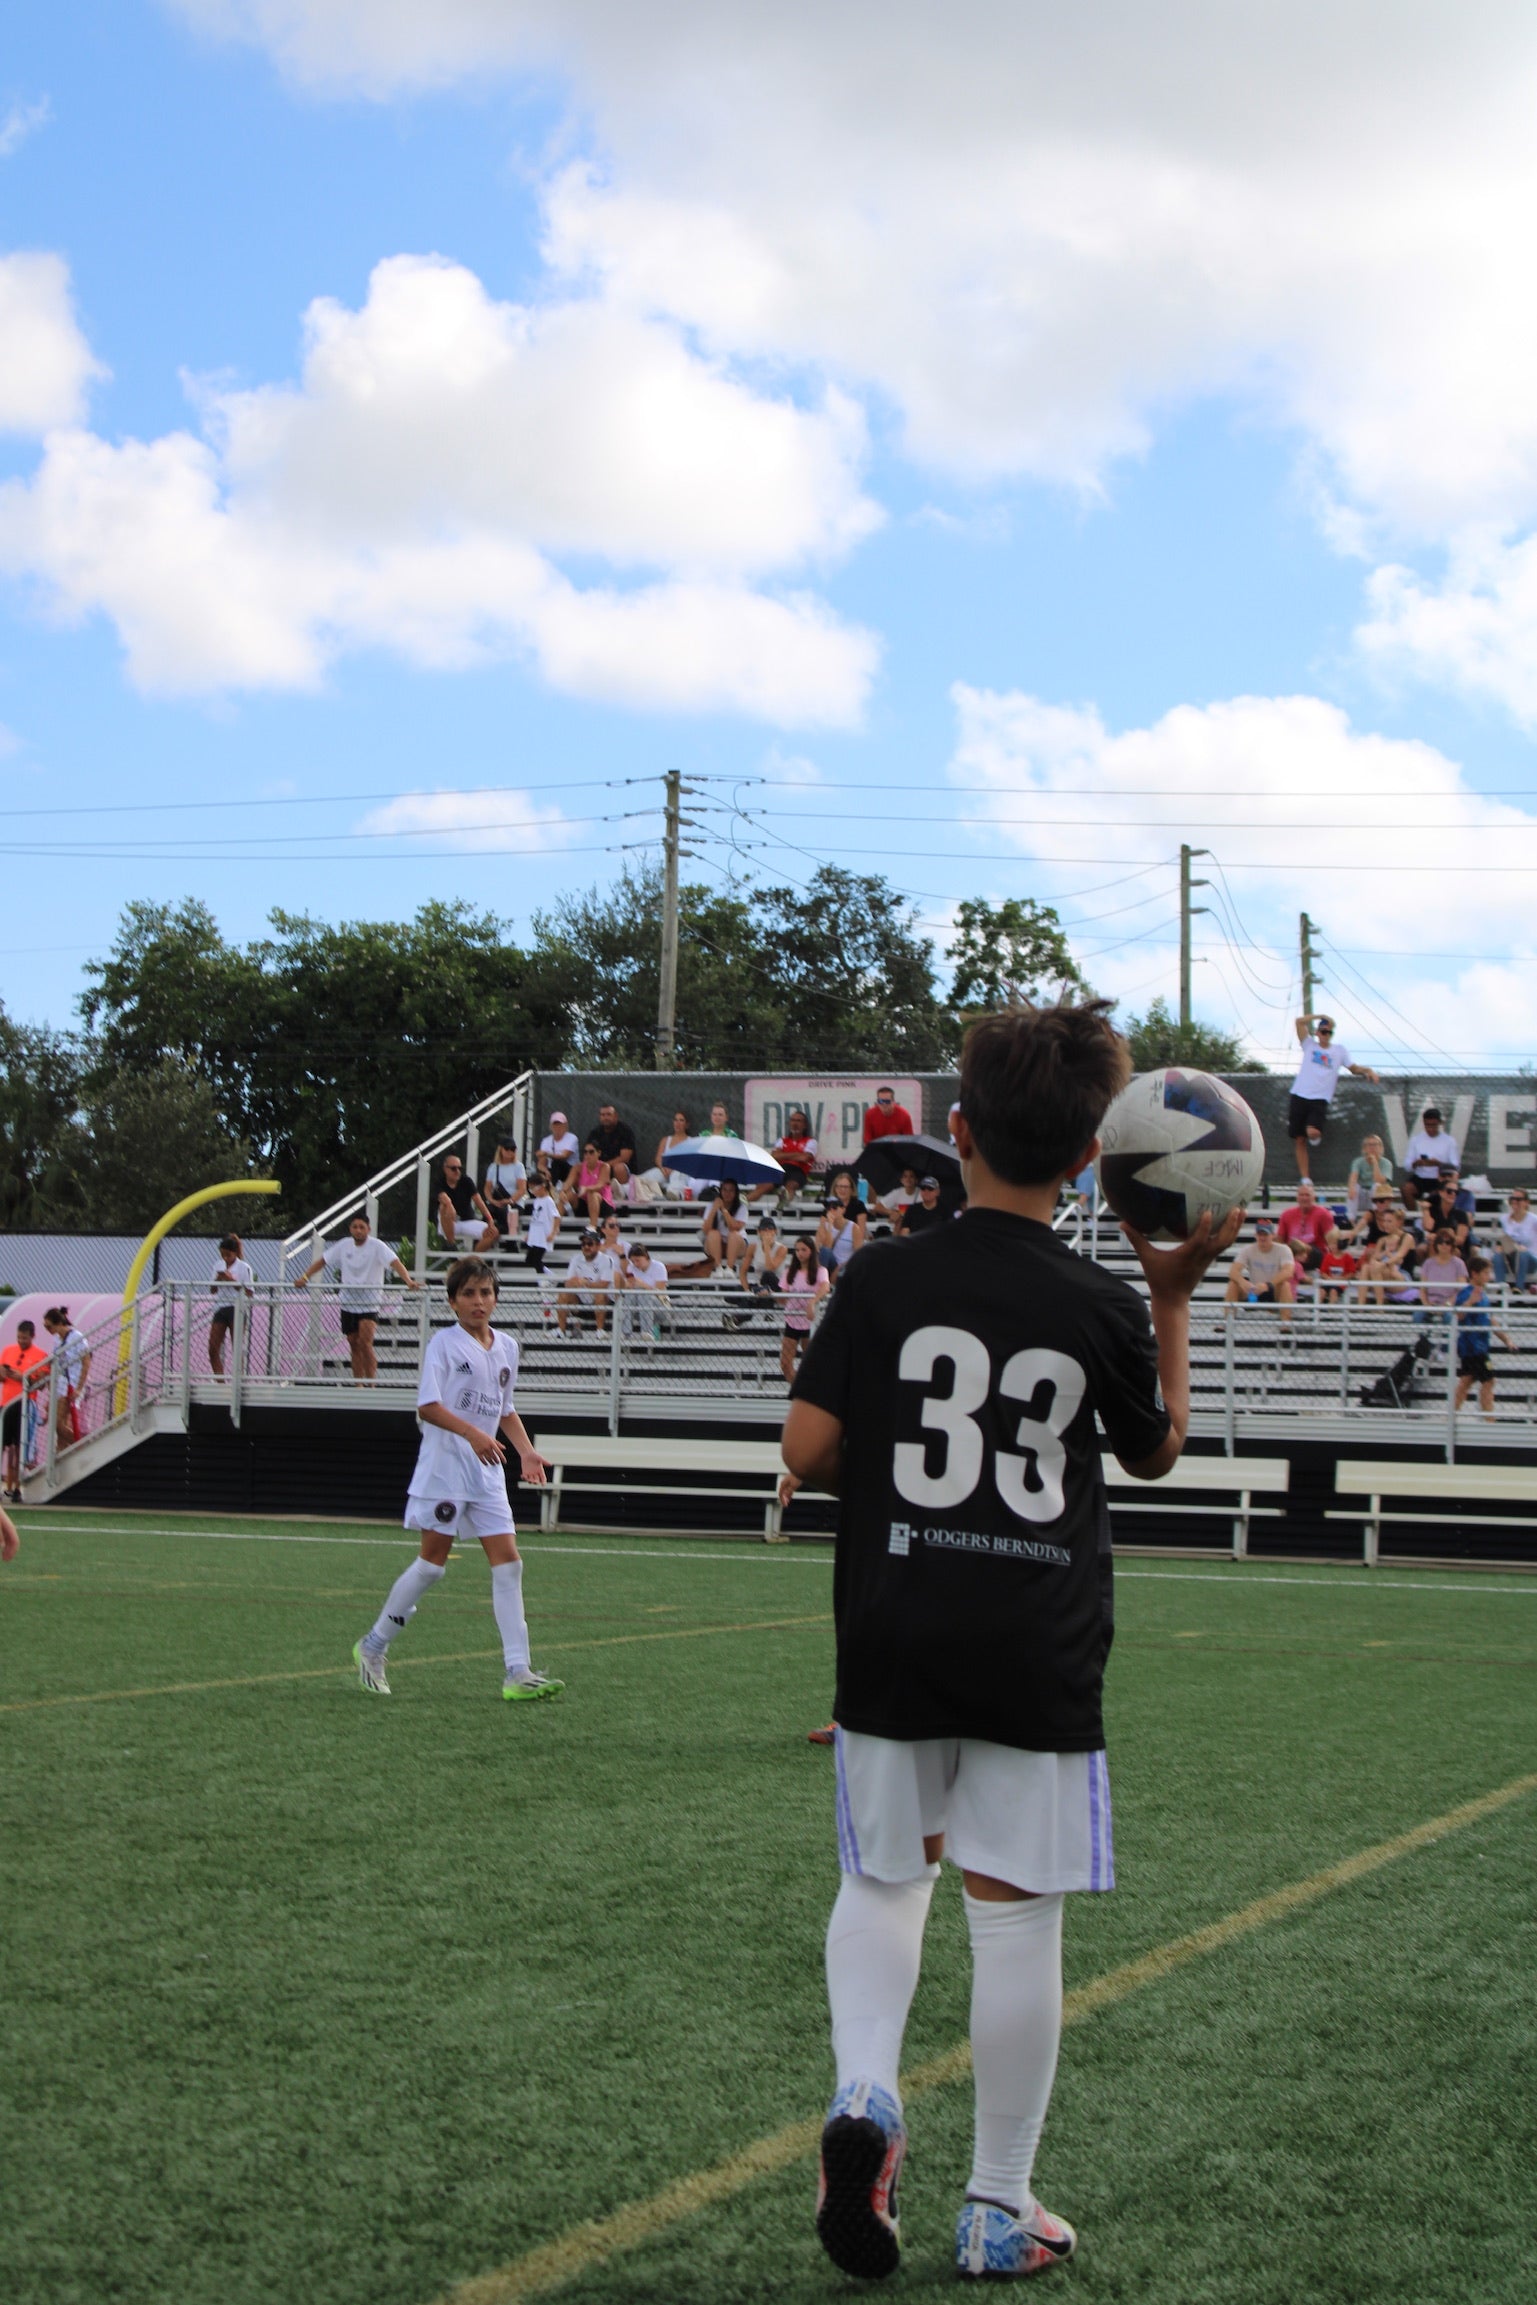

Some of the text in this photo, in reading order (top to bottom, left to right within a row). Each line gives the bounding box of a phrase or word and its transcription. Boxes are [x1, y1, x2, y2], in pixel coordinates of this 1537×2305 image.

[808, 1080, 857, 1088] DRIVE PINK
[1382, 1095, 1537, 1168] WE
[893, 1325, 1087, 1523] 33
[923, 1528, 1072, 1562] ODGERS BERNDTSN
